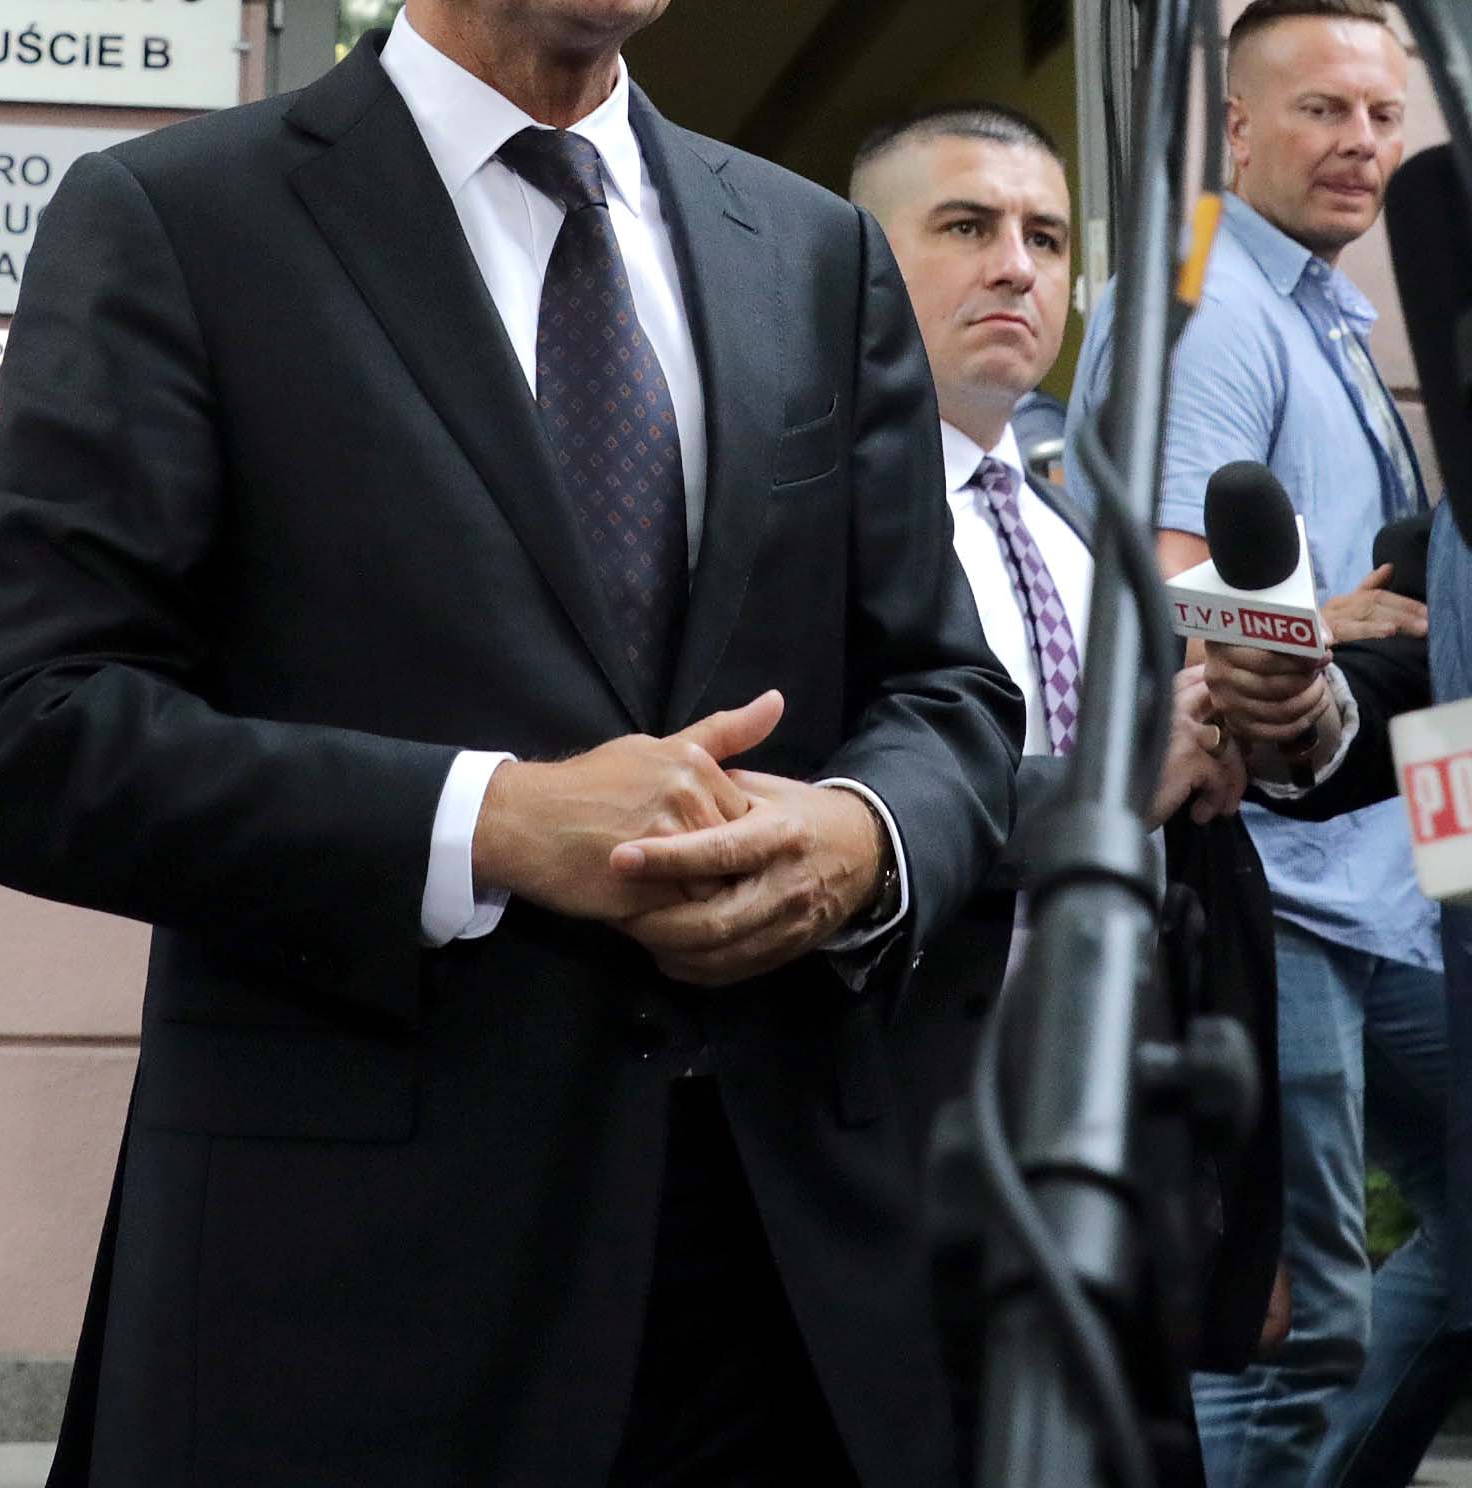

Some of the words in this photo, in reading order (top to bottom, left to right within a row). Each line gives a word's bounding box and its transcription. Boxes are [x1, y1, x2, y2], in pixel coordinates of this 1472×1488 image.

[143, 36, 171, 69] B
[1174, 603, 1234, 628] TVP
[1245, 613, 1311, 642] INFO
